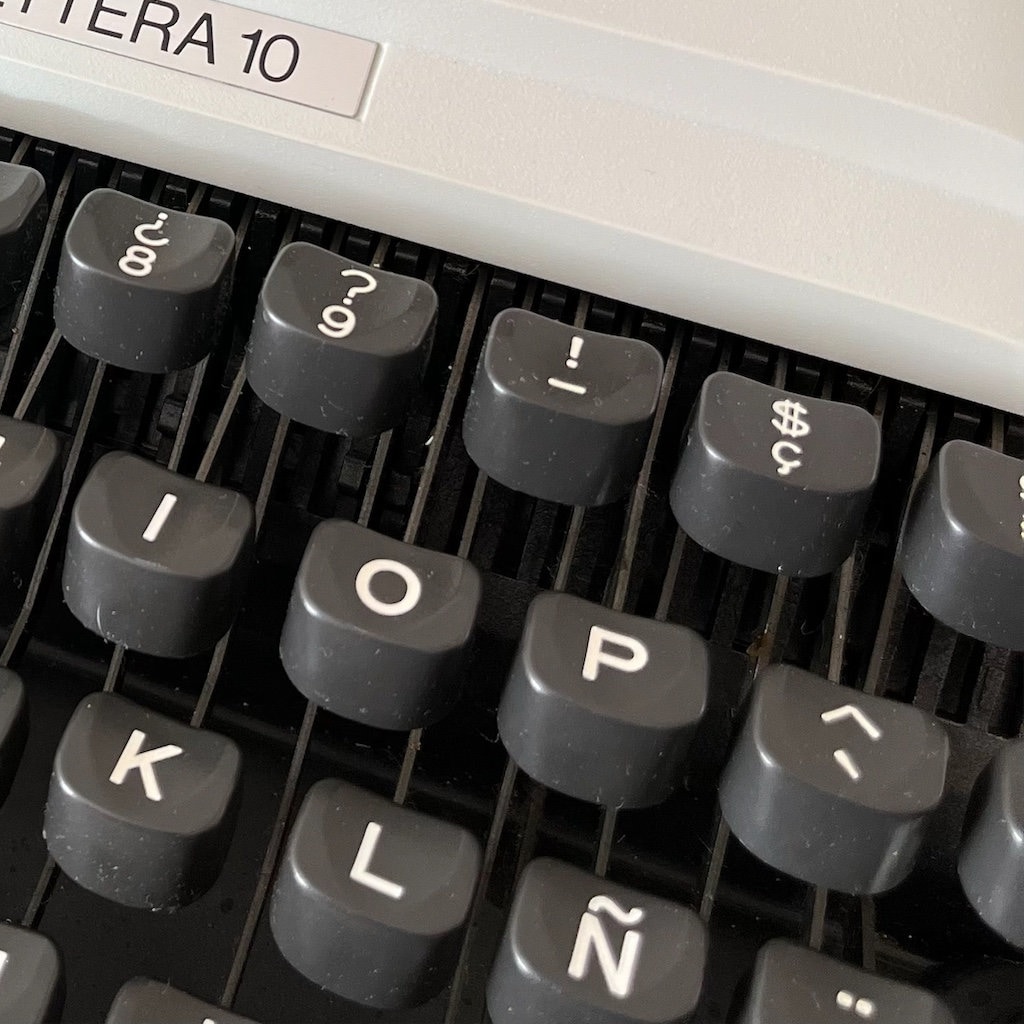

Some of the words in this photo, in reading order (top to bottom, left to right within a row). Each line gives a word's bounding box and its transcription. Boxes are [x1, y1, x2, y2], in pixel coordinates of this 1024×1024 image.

[241, 29, 300, 83] 10
[118, 245, 157, 277] 8
[340, 269, 378, 306] ?
[317, 305, 356, 339] 9
[566, 336, 584, 369] !
[771, 398, 811, 439] $
[142, 493, 177, 542] I
[355, 558, 422, 617] O
[582, 625, 649, 681] P
[109, 729, 183, 802] K
[349, 821, 405, 899] L
[567, 895, 644, 998] Ñ
